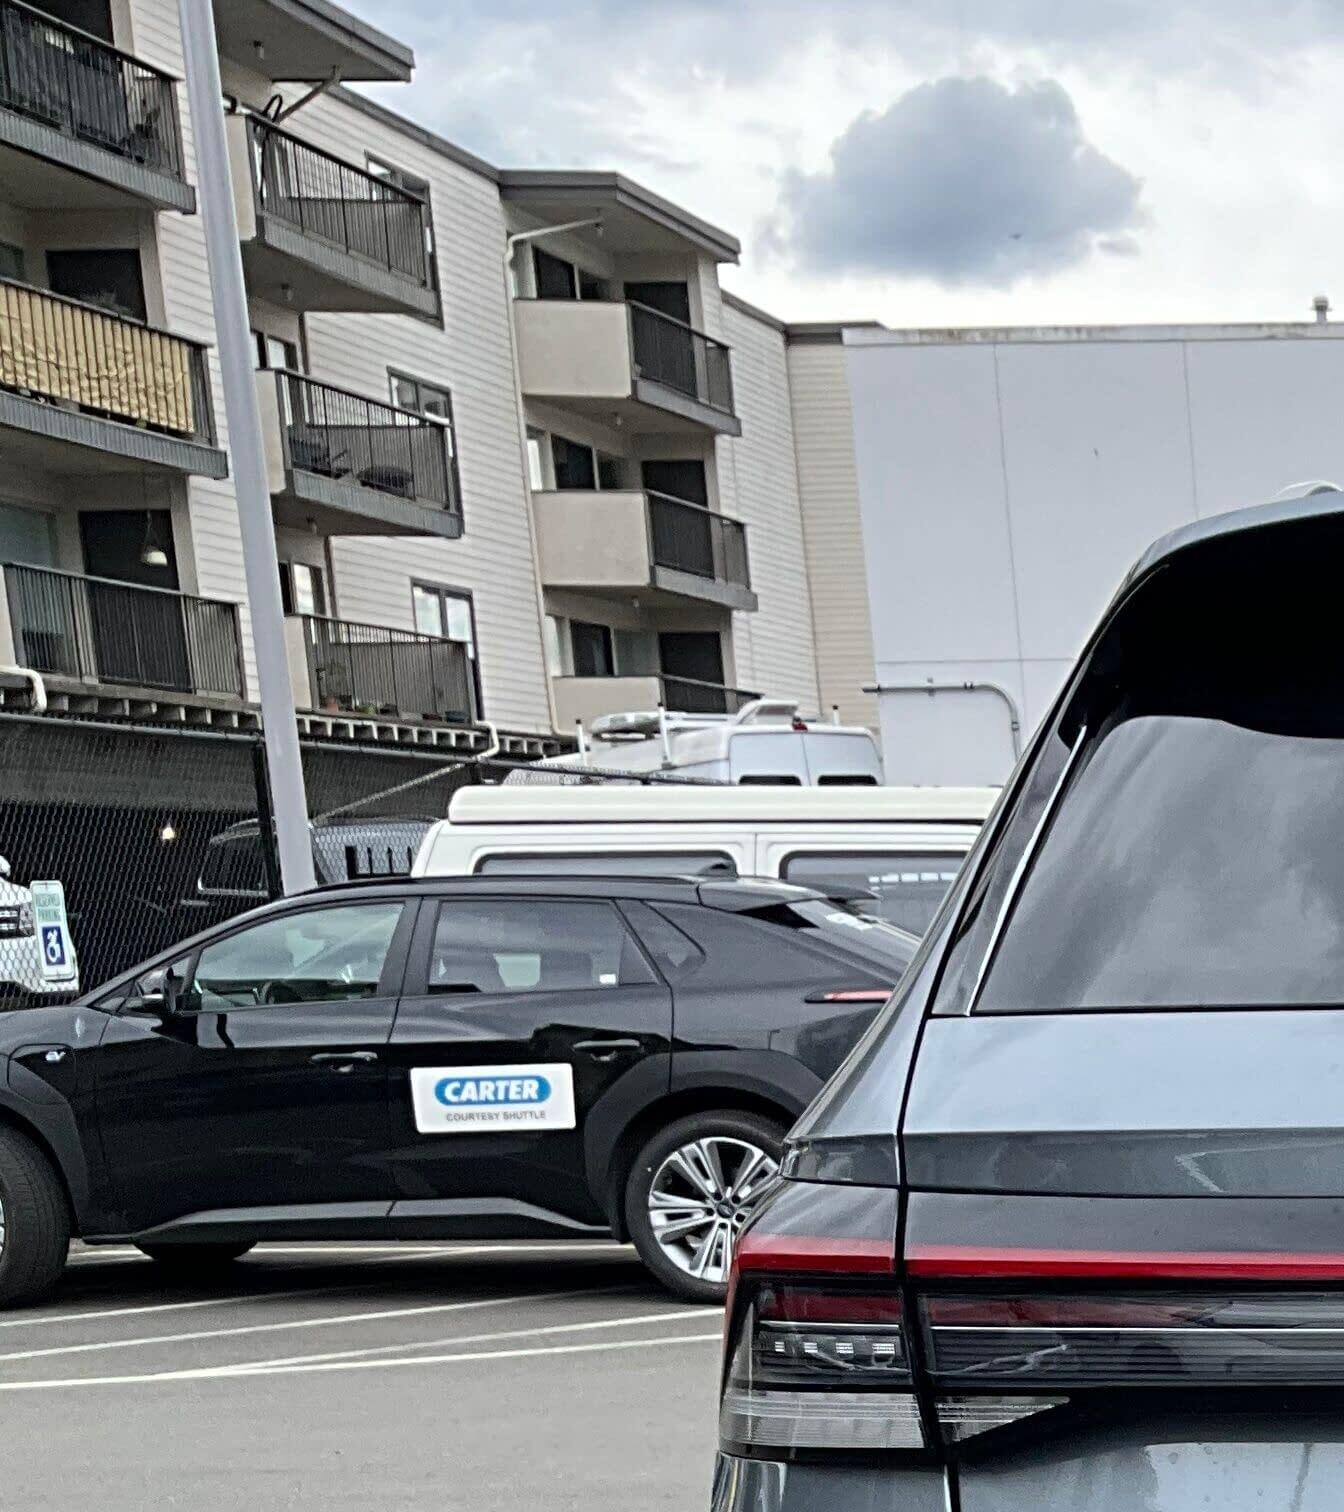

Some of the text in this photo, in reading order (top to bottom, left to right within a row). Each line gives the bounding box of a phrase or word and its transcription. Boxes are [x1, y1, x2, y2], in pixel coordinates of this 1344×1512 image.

[444, 1079, 540, 1103] CARTER
[446, 1110, 547, 1122] COURTESY SHUTTLE
